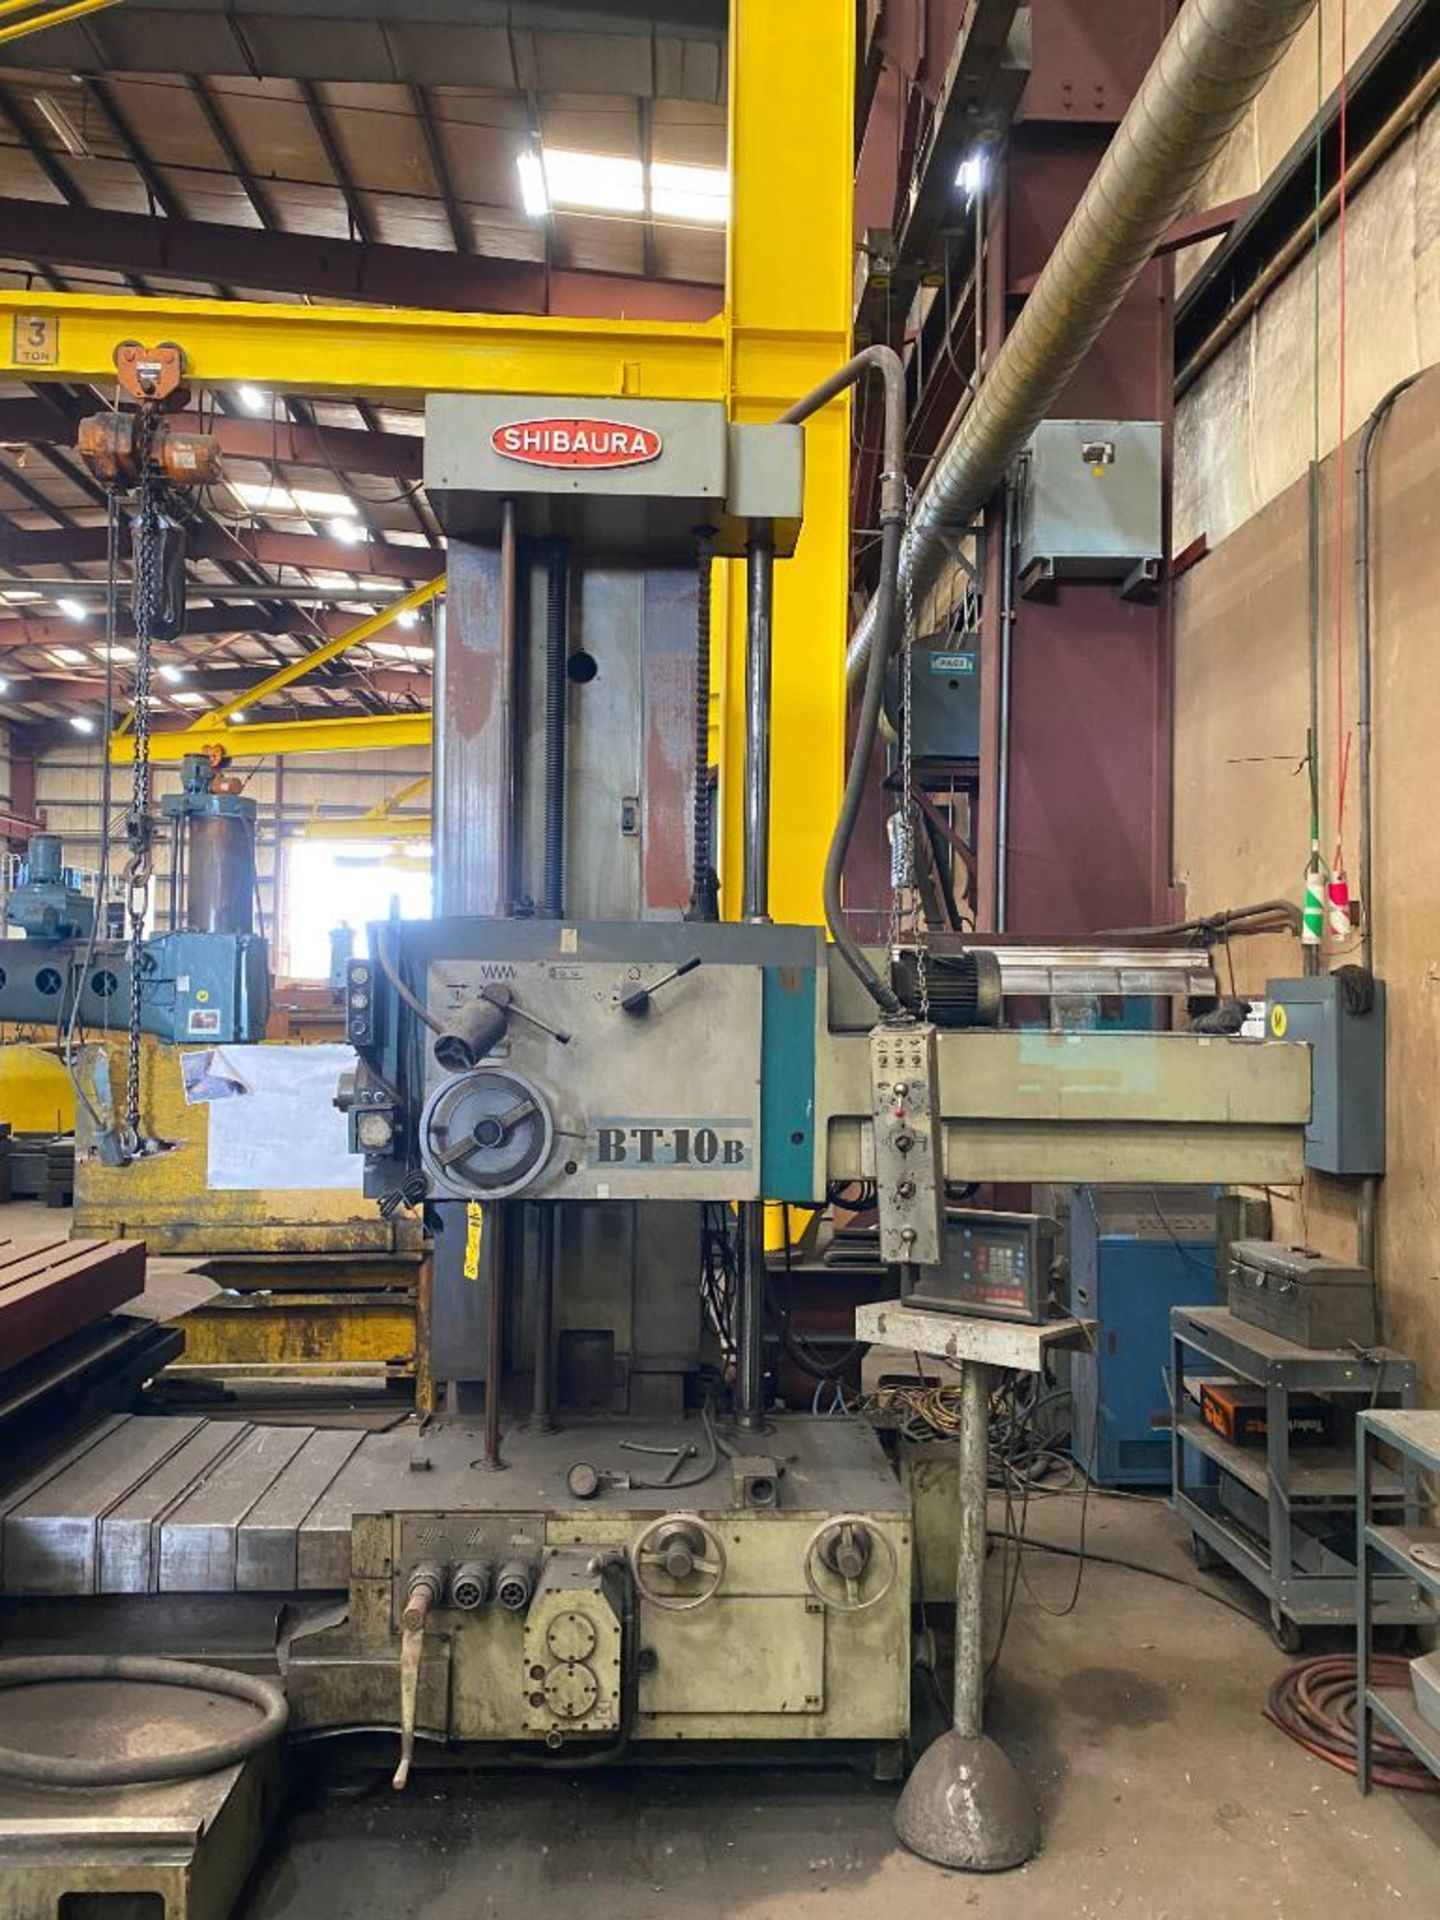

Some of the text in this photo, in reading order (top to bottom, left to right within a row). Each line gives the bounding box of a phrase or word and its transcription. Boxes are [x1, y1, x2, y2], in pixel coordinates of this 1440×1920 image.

[28, 321, 46, 347] 3
[21, 351, 50, 361] TON
[503, 428, 649, 454] SHIBAURA
[596, 1128, 745, 1164] BT-10B
